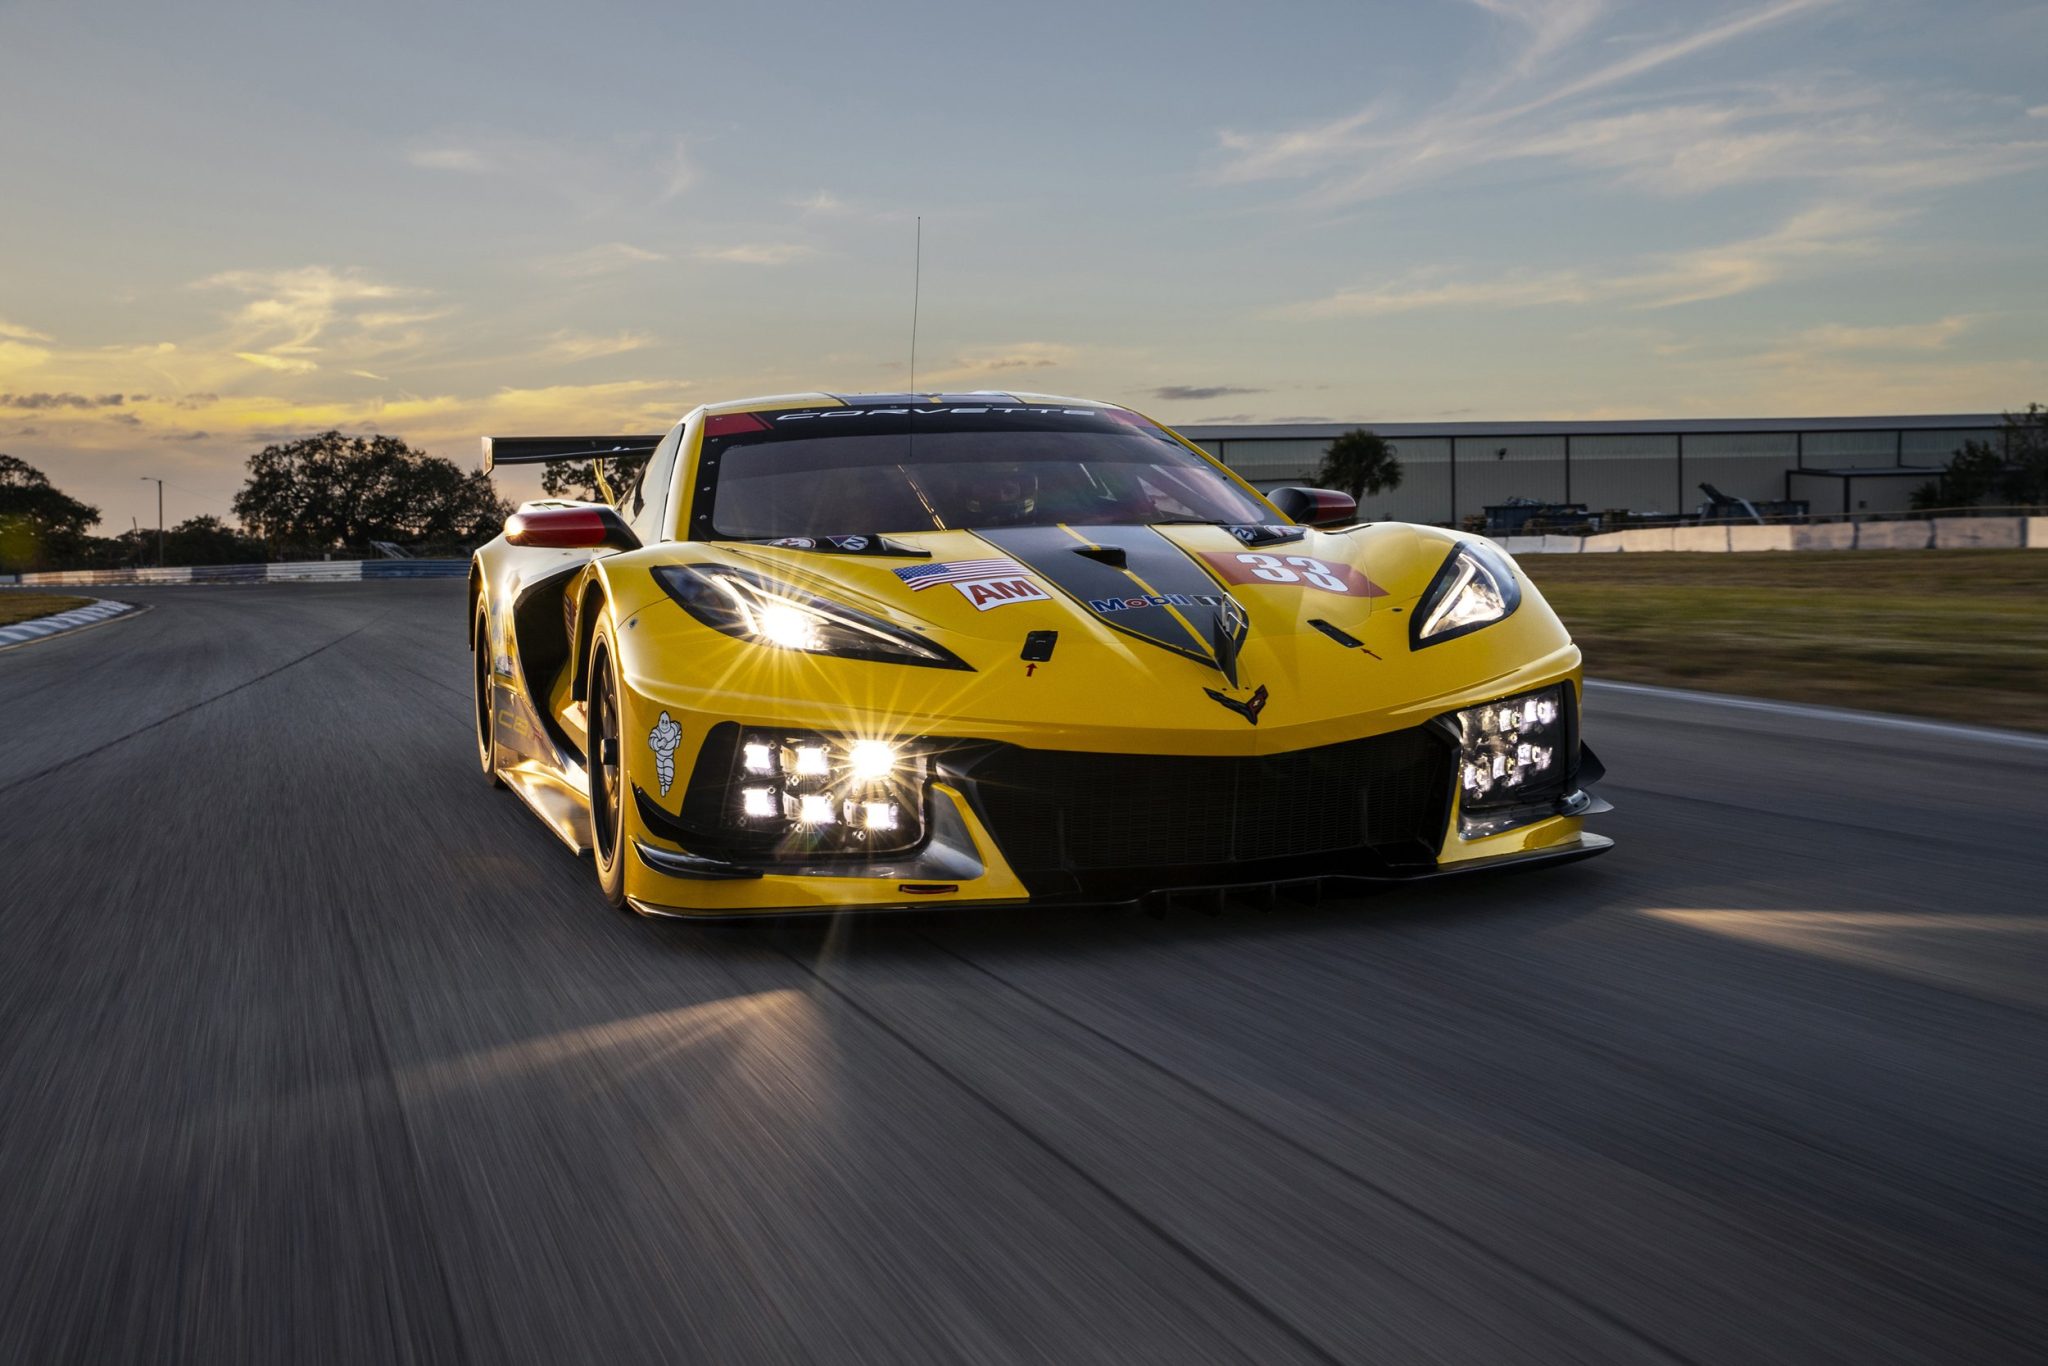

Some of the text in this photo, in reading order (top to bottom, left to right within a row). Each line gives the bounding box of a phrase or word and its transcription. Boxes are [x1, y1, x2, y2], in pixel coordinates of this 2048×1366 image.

[776, 408, 1096, 421] CORVETTE
[1235, 553, 1350, 593] 33
[967, 580, 1042, 606] AM
[1089, 593, 1193, 613] Mobil
